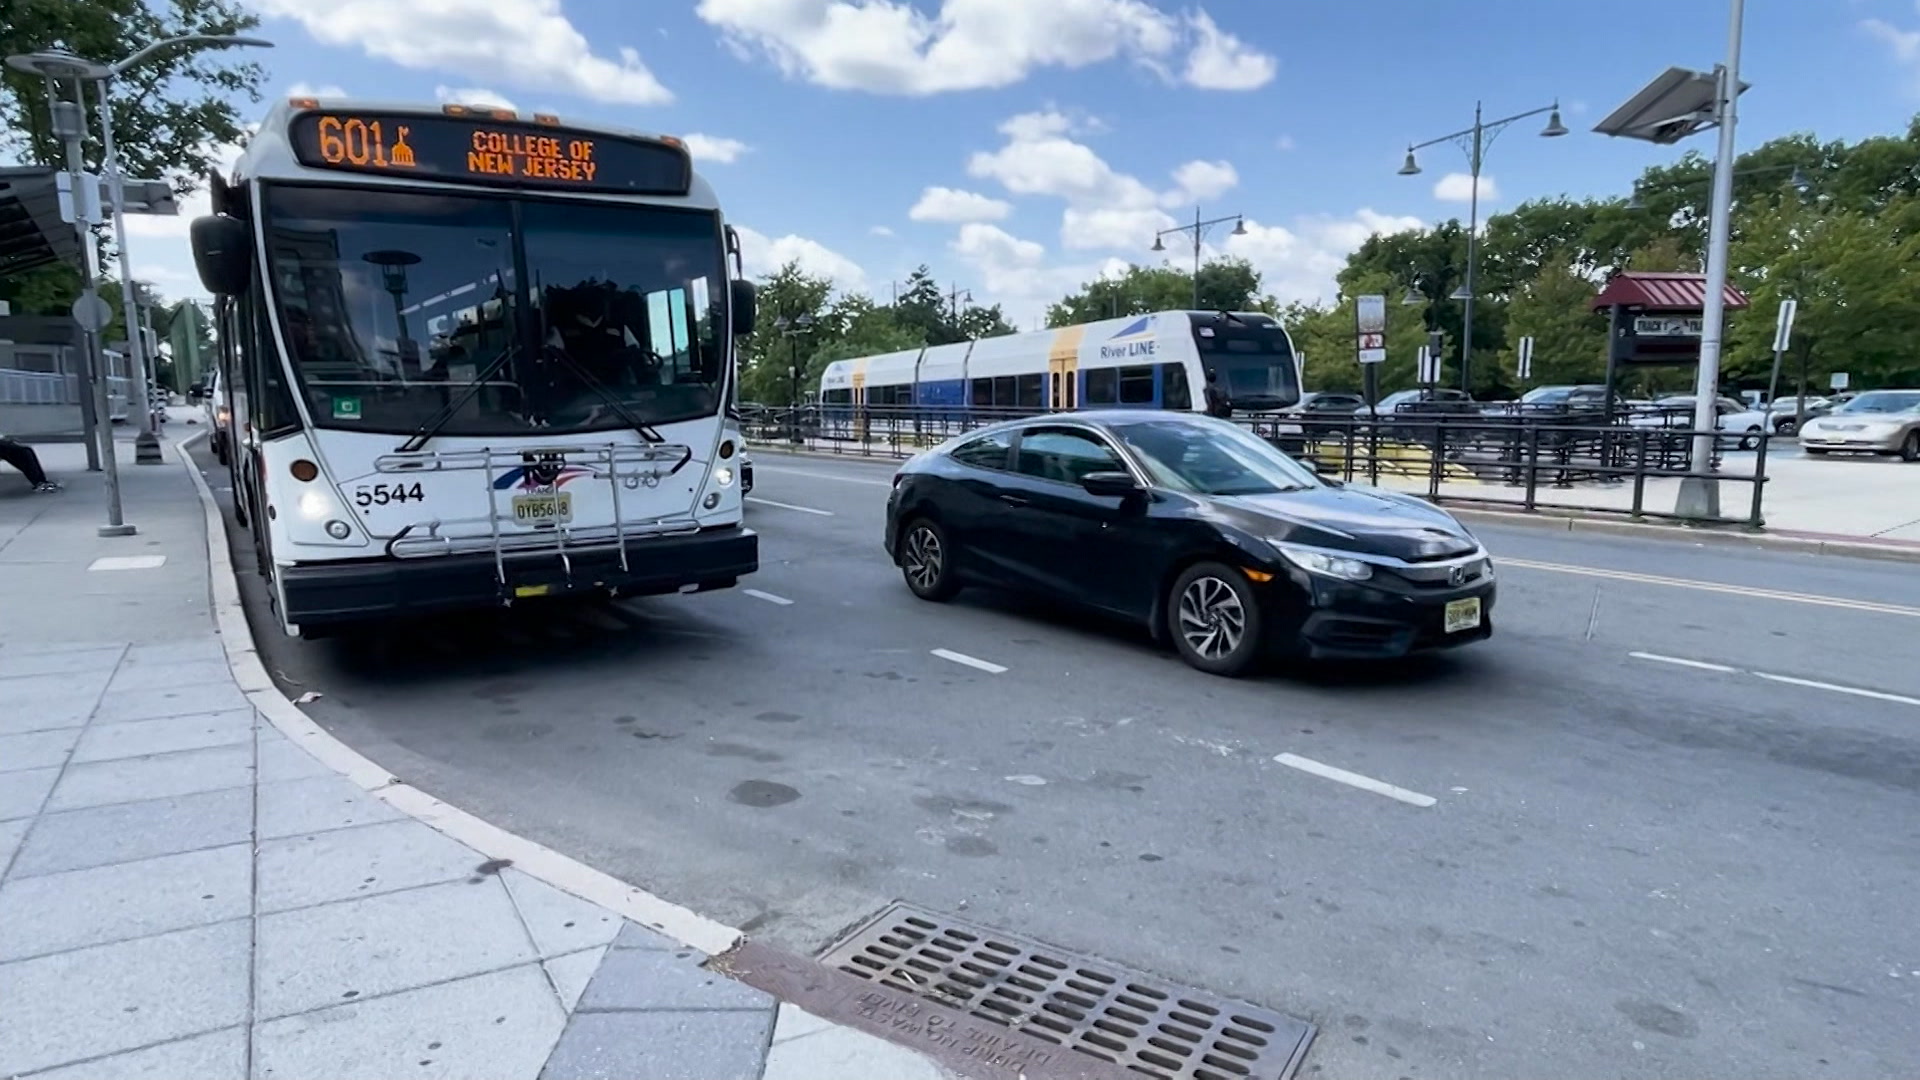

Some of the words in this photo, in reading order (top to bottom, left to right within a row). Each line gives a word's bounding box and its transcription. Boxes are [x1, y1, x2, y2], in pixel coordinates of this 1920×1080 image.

[319, 116, 388, 167] 601
[472, 131, 563, 159] COLLEGE
[569, 140, 594, 161] OF
[467, 151, 514, 175] NEW
[522, 156, 596, 181] JERSEY
[1101, 346, 1127, 359] River
[1129, 340, 1155, 357] LINE
[356, 482, 424, 506] 5544
